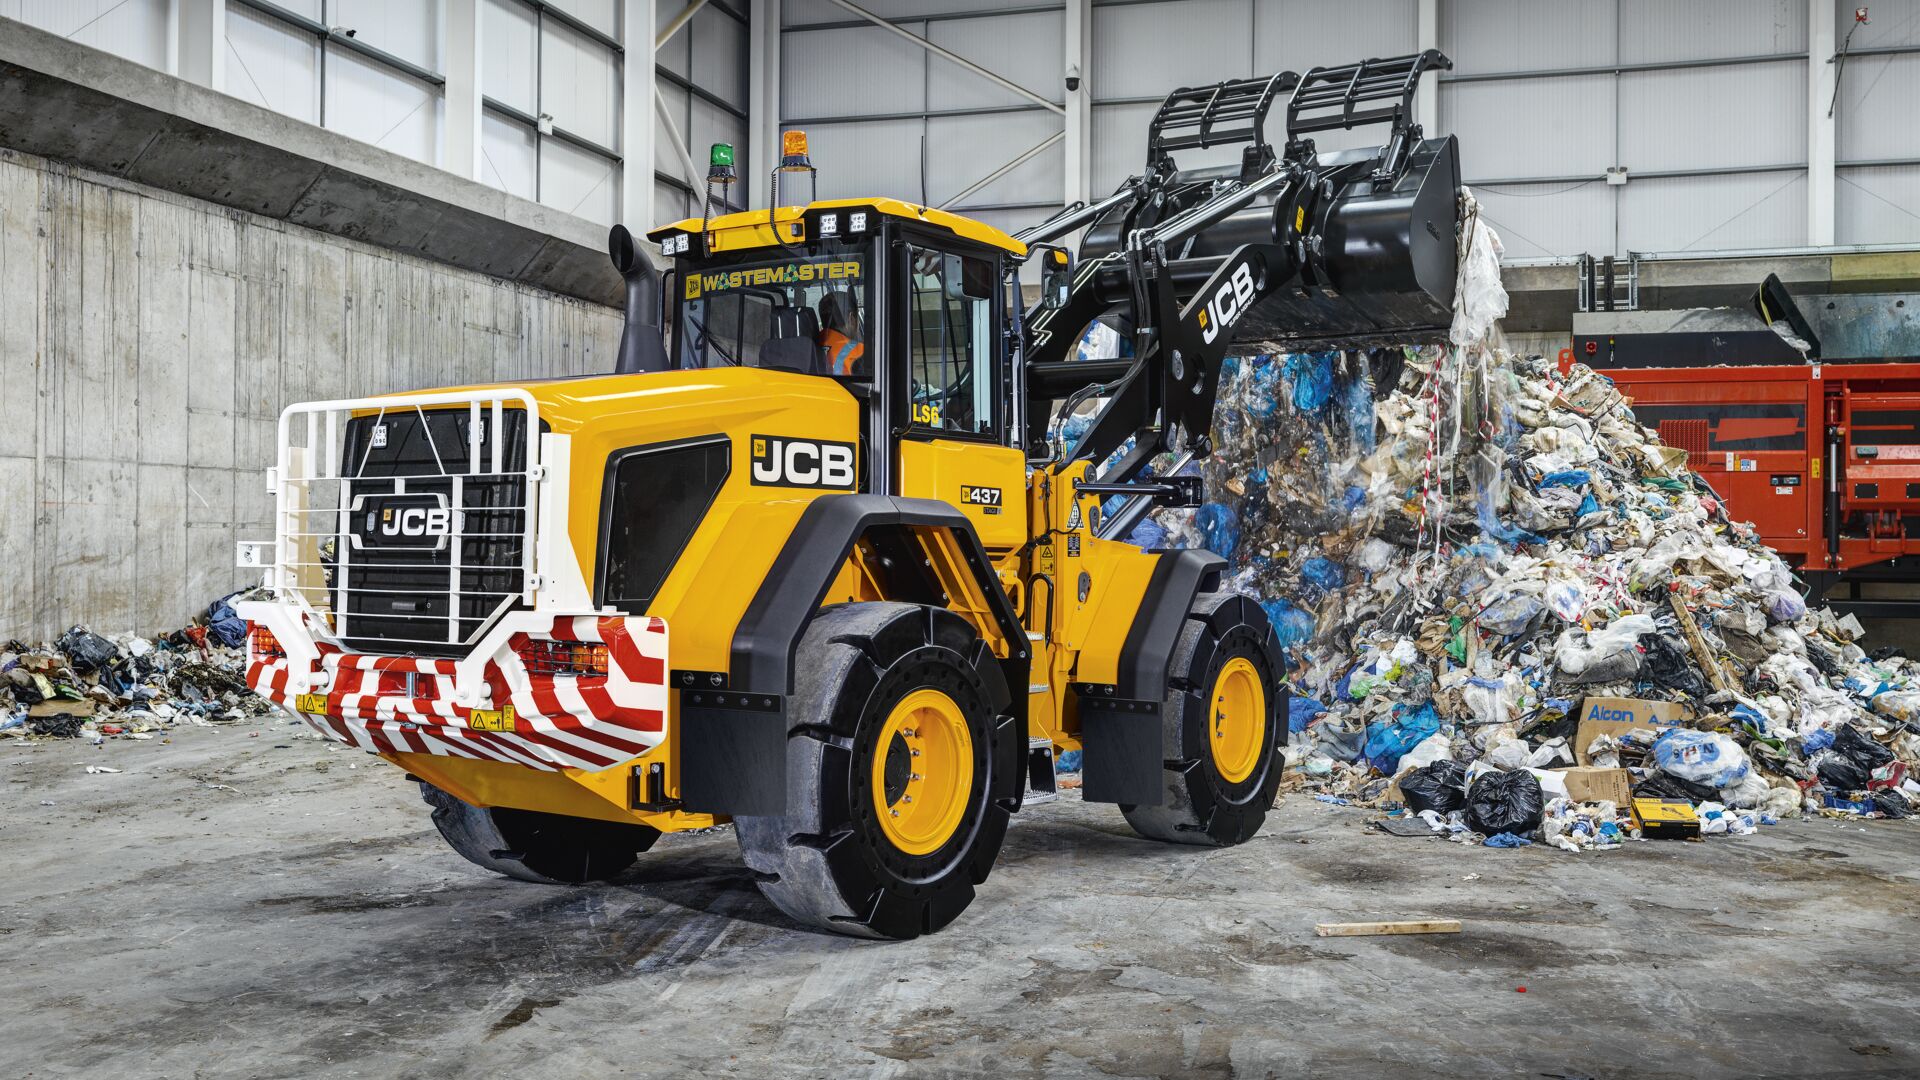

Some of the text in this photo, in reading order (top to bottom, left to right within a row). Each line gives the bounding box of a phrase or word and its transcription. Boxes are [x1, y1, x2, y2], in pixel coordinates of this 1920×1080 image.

[703, 261, 860, 292] WASTEMASTER
[1203, 262, 1254, 345] JCB
[912, 403, 939, 425] LS6
[753, 440, 854, 486] JCB
[970, 488, 1000, 504] 437
[382, 508, 450, 536] JCB
[1587, 704, 1634, 722] Alcon
[1648, 714, 1685, 727] Aon
